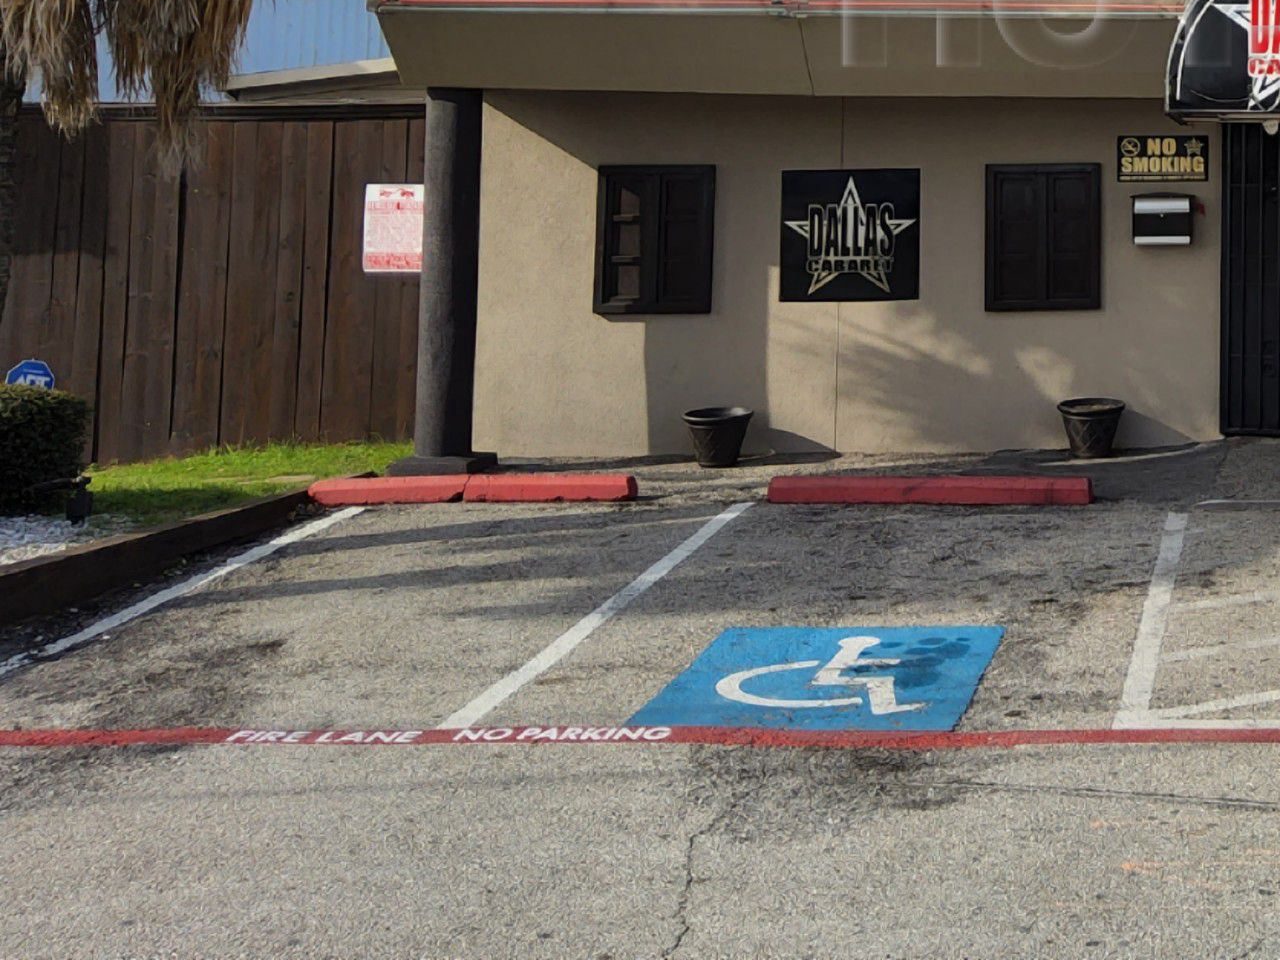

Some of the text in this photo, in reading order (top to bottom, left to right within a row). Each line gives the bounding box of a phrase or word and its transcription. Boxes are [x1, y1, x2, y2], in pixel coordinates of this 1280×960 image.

[1146, 138, 1177, 156] NO
[1121, 156, 1205, 173] SMOKING
[808, 203, 895, 259] DALLAS
[806, 259, 894, 273] CABARET
[225, 726, 672, 743] FIRE LANE NO PARKING
